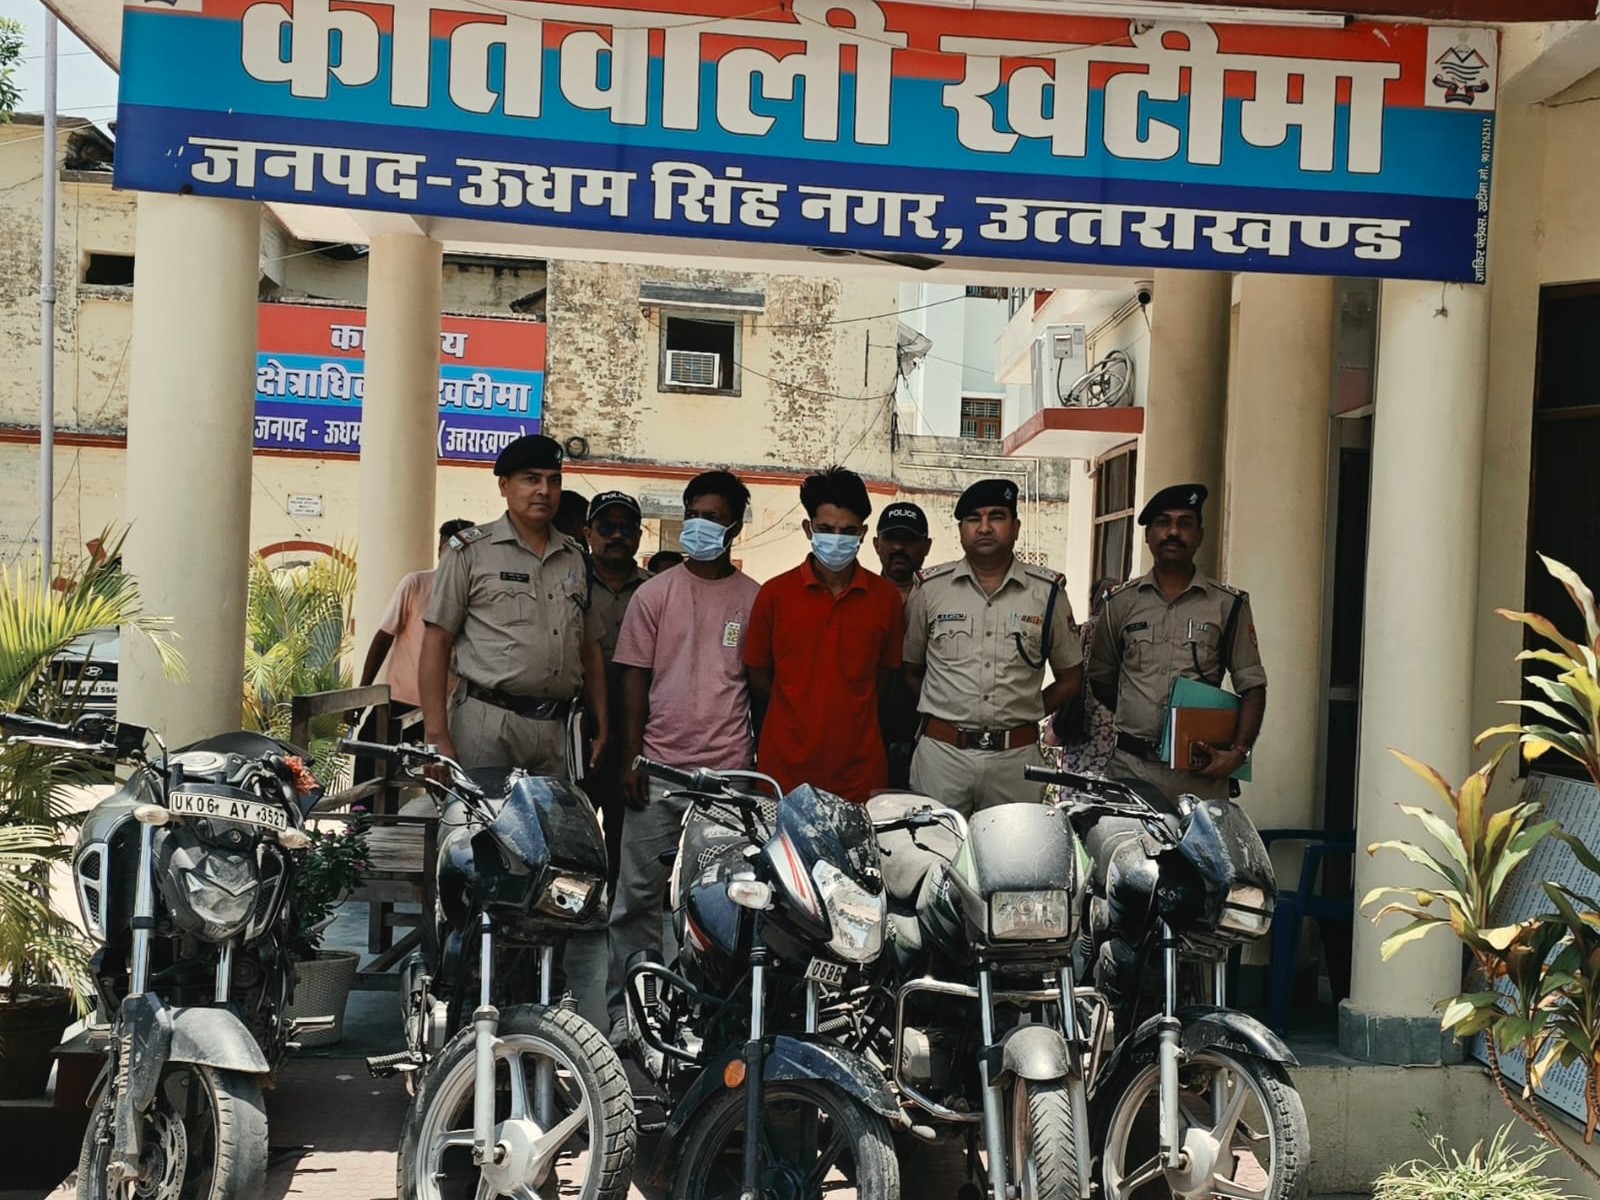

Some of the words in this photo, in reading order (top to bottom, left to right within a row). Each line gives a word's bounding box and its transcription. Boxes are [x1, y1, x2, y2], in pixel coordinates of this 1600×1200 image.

[939, 20, 1400, 174] खटीमा
[650, 160, 788, 229] सिंह
[799, 184, 964, 251] नगर,
[975, 196, 1410, 260] उत्तराखण्ड
[254, 415, 308, 442] जनपद
[888, 509, 917, 519] POLICE
[175, 796, 215, 813] UK06
[229, 803, 250, 819] AY
[260, 805, 286, 828] 3527
[118, 1033, 132, 1096] YAMAHA
